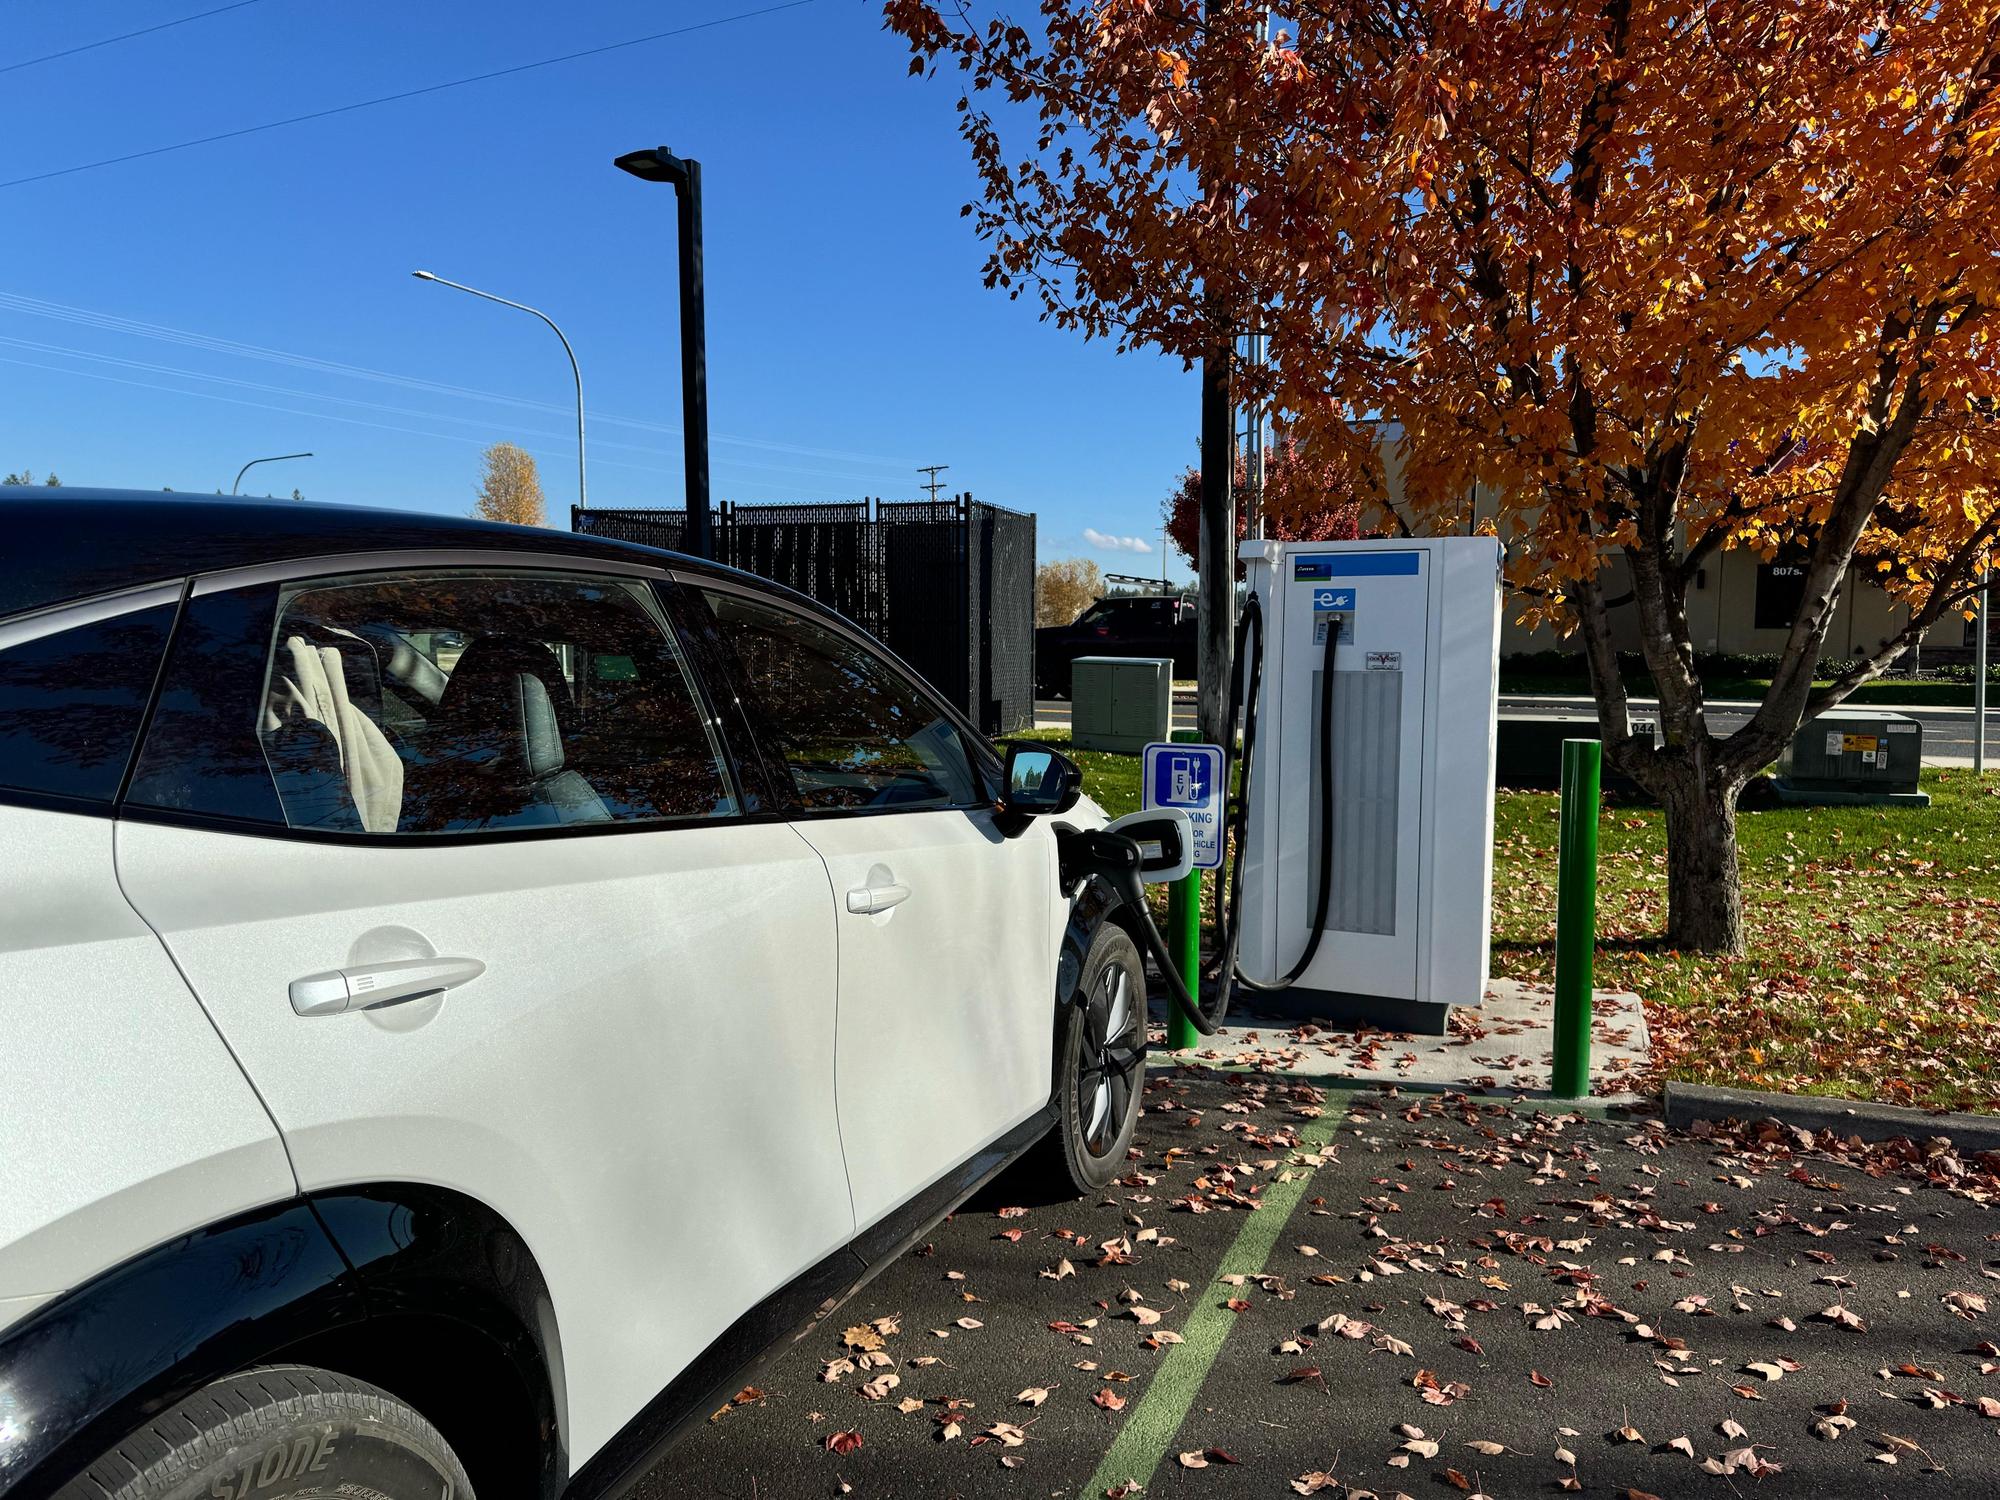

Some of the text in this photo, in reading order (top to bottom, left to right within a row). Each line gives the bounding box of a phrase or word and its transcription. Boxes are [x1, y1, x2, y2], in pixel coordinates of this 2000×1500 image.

[1188, 811, 1213, 824] KING
[1193, 829, 1204, 838] OR
[1193, 840, 1216, 849] HICLE
